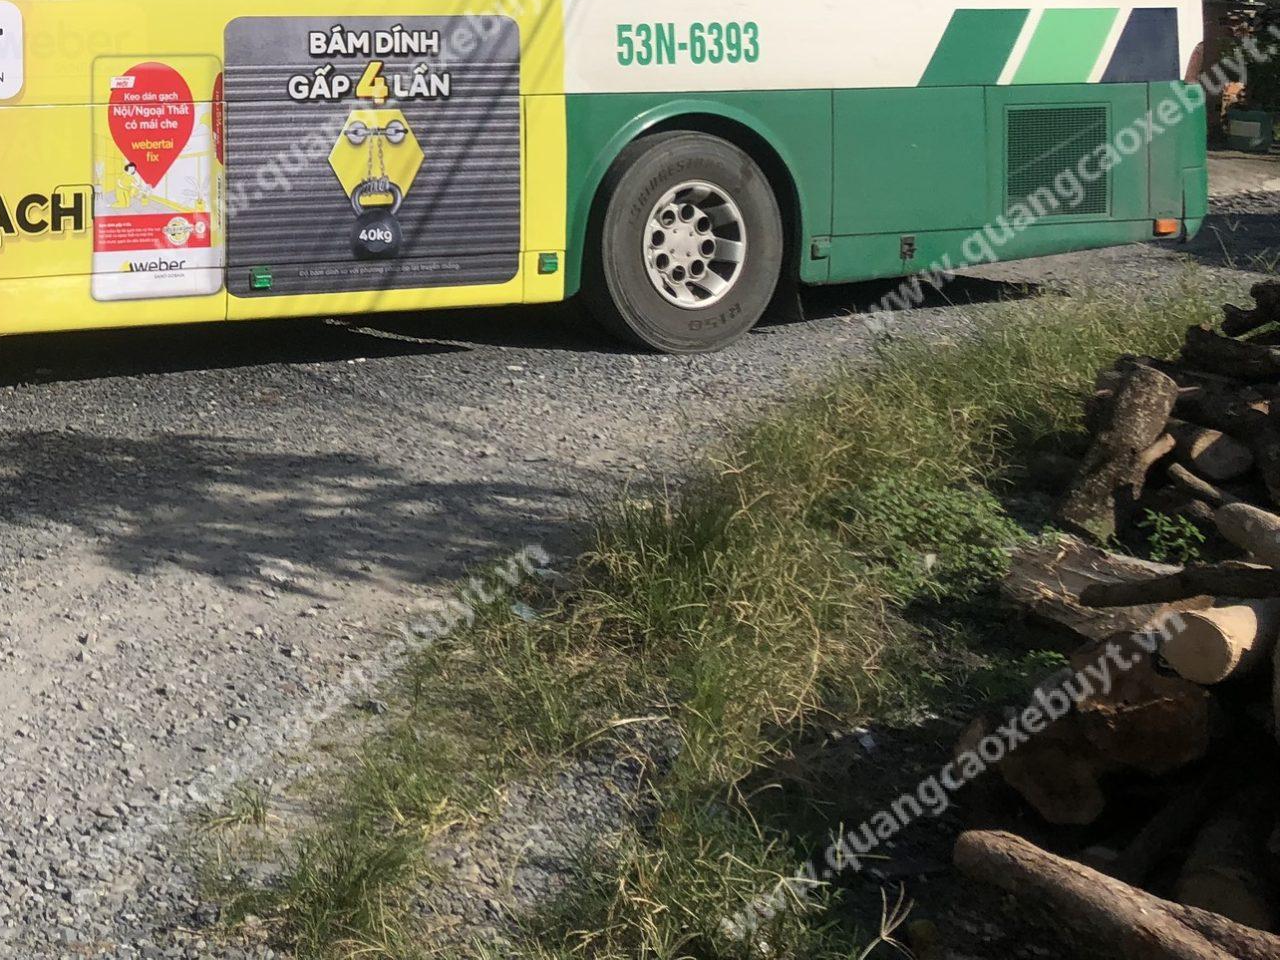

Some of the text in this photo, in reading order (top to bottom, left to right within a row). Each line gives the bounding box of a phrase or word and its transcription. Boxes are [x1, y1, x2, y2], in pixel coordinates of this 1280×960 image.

[309, 24, 439, 55] BÁM DÍNH
[616, 21, 760, 66] 53N-6393
[288, 60, 450, 103] GẤP 4 LẦN
[124, 91, 178, 102] Keo dán gạch
[113, 103, 189, 117] Nội/Ngoại Thất
[125, 119, 178, 130] có mái che
[131, 138, 174, 150] webertai
[146, 151, 159, 162] fix
[359, 228, 393, 243] 40kg
[134, 258, 186, 272] weber
